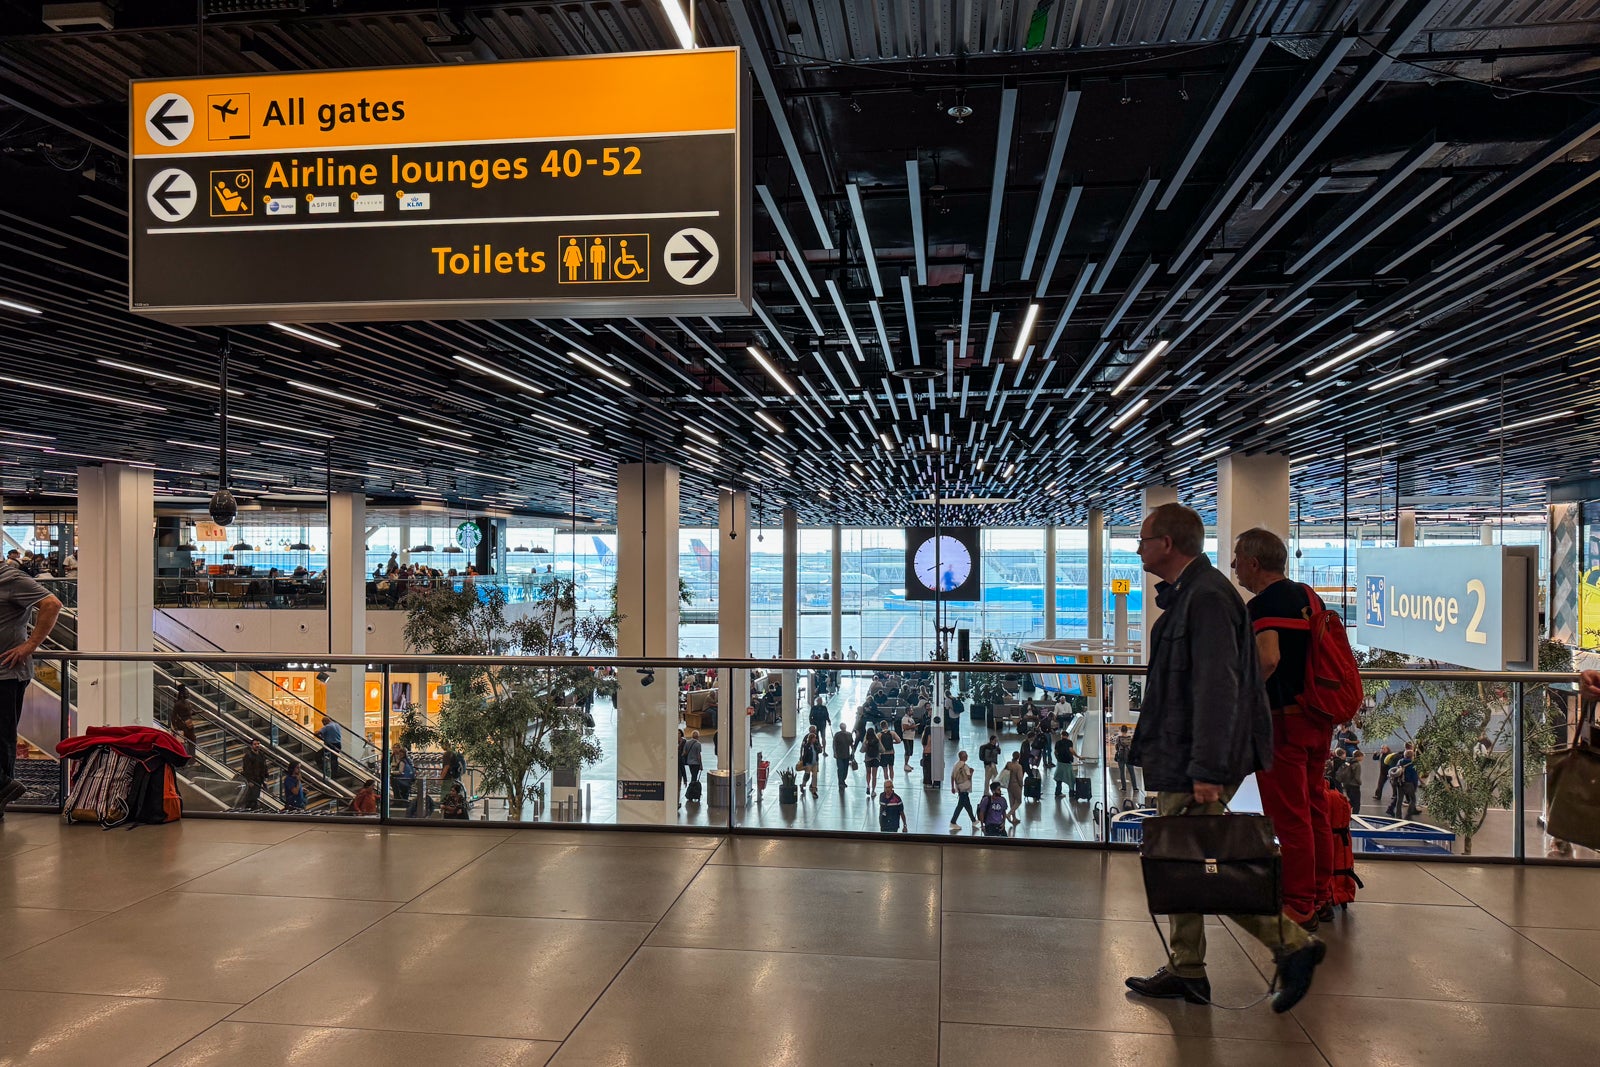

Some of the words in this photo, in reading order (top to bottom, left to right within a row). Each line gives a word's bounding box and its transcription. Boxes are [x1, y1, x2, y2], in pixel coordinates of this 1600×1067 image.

[262, 97, 304, 127] All
[317, 98, 405, 132] gates
[264, 157, 378, 189] Airline
[391, 154, 529, 189] lounges
[541, 146, 642, 178] 40-52
[431, 244, 546, 275] Toilets
[1390, 585, 1459, 633] Lounge
[1465, 578, 1487, 645] 2
